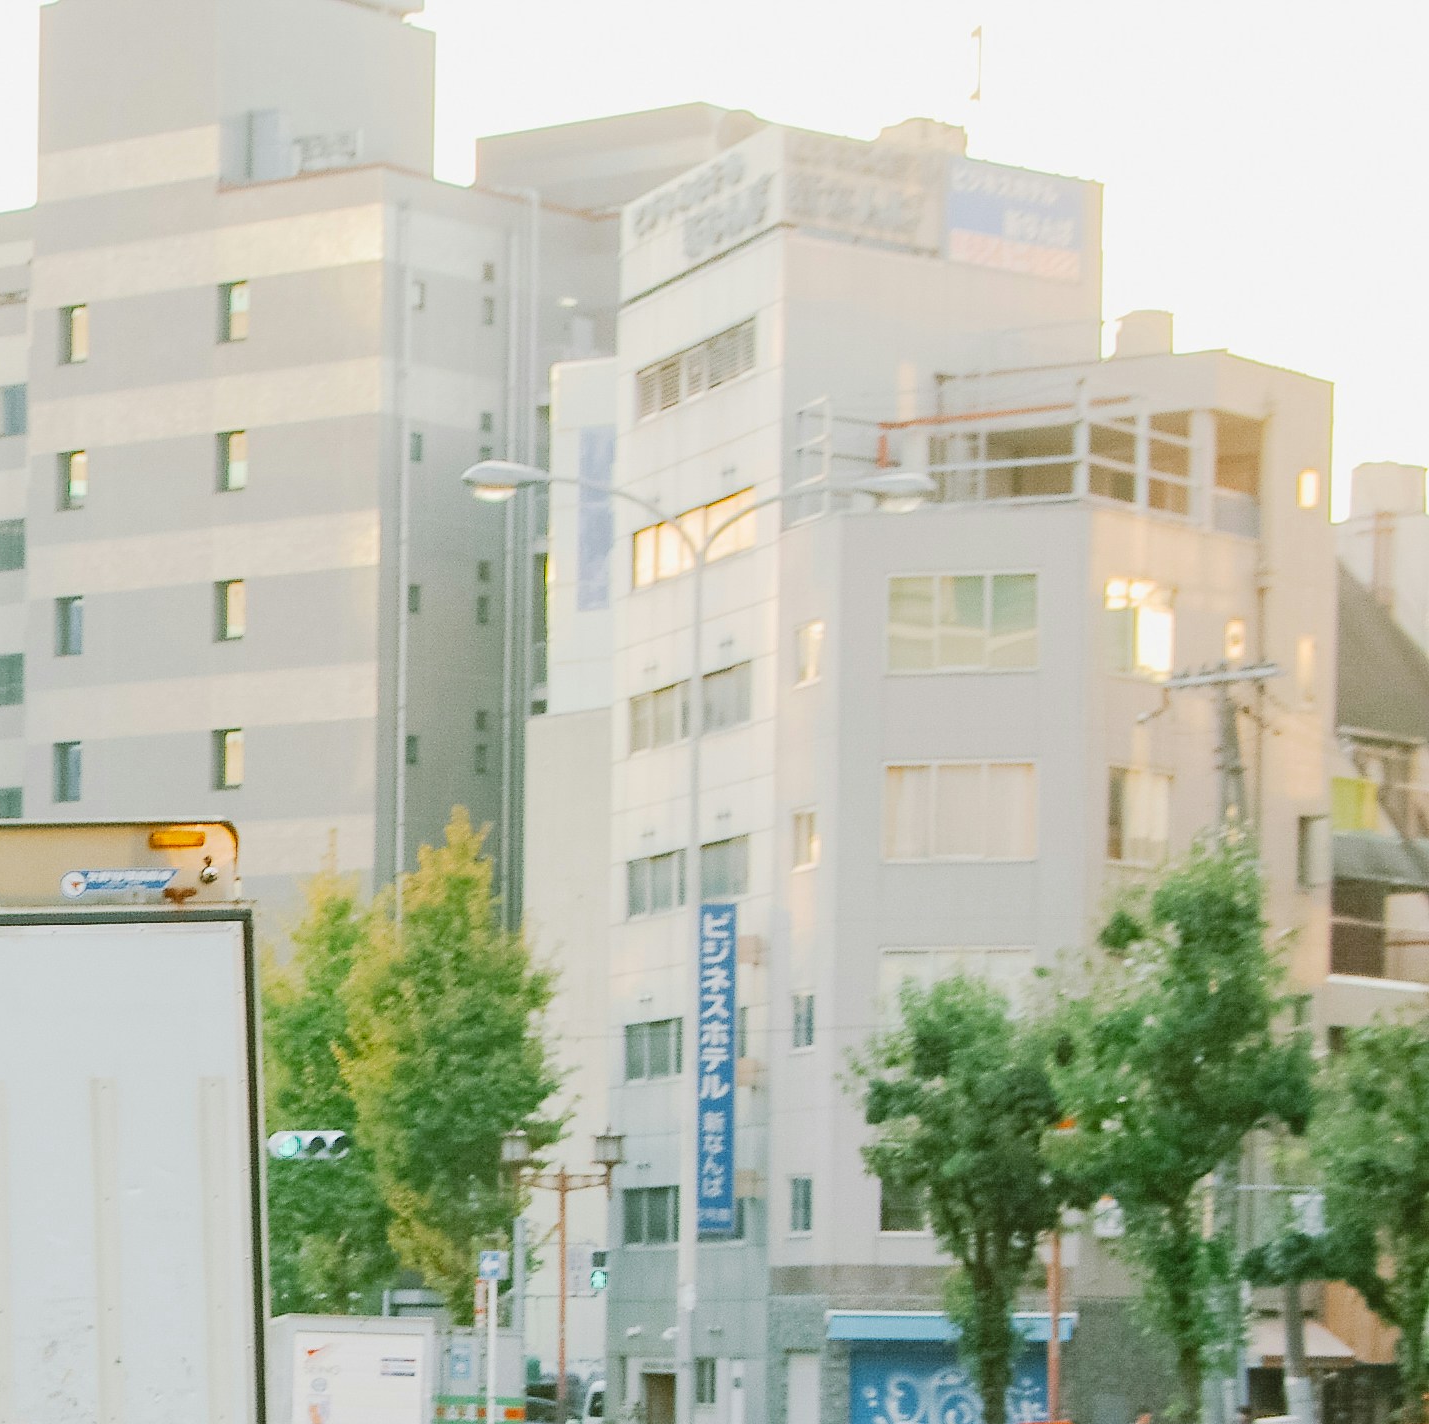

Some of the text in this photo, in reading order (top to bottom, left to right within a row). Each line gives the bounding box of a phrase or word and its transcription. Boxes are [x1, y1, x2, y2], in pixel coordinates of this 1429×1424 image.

[701, 912, 732, 1099] ビジネスホテル
